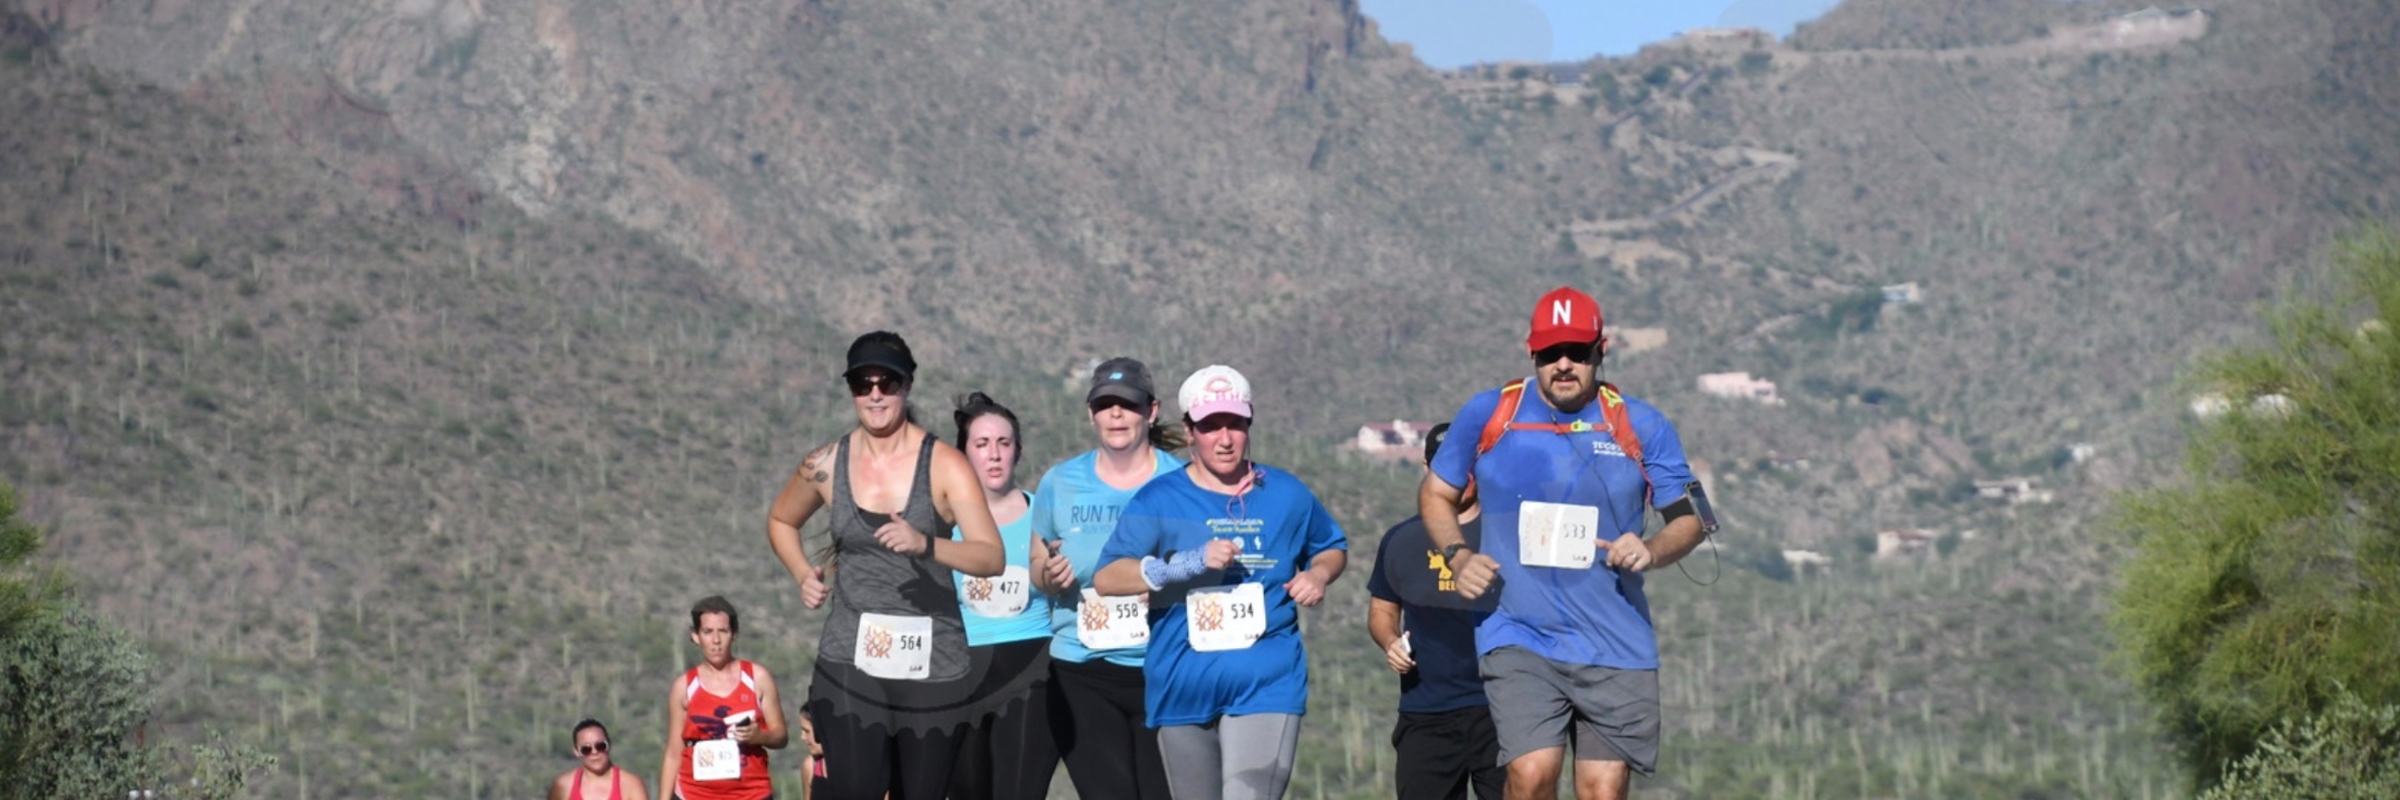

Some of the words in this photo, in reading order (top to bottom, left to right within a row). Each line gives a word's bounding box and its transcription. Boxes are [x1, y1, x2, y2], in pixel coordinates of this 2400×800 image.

[1552, 299, 1572, 325] N
[1071, 504, 1103, 523] RUN
[1000, 581, 1020, 595] 477
[1116, 603, 1139, 619] 558
[1231, 602, 1254, 619] 534
[900, 635, 922, 651] 564
